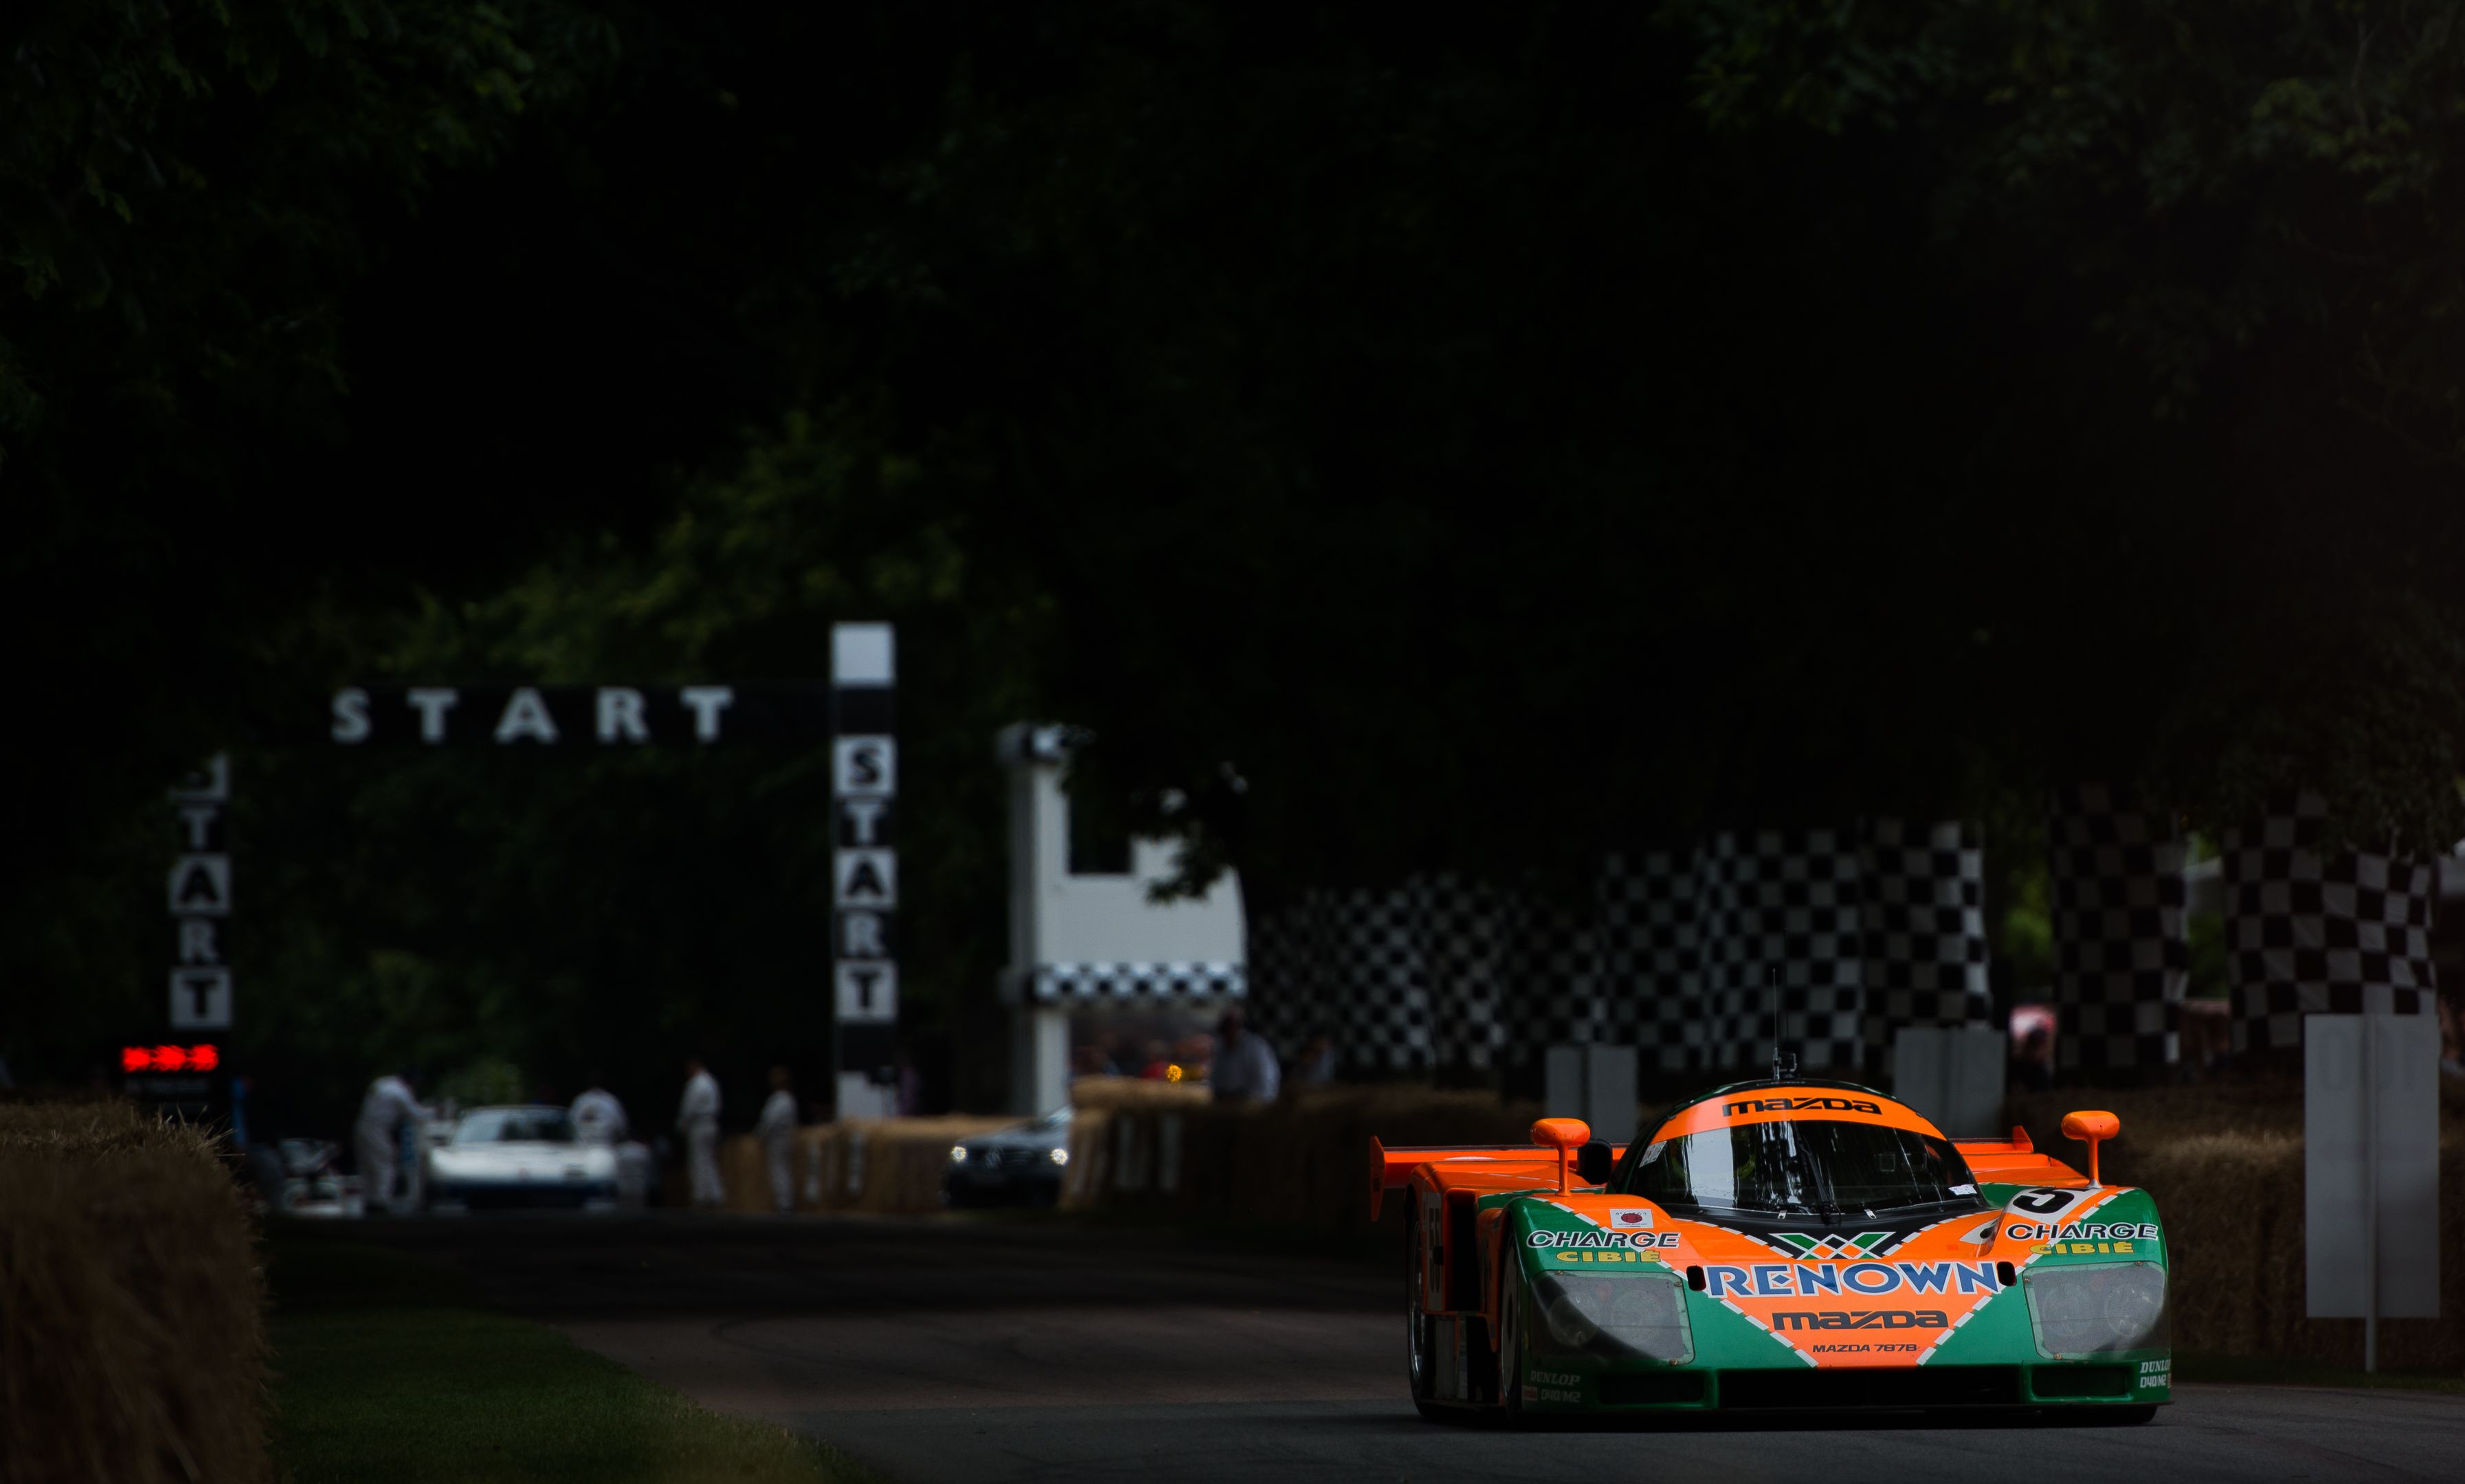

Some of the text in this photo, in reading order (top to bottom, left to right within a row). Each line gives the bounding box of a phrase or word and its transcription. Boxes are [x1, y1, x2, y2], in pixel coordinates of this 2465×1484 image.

[330, 686, 735, 746] START
[842, 746, 889, 1009] START
[1722, 1097, 1882, 1116] mazda
[1526, 1230, 1682, 1249] CHARGE
[2005, 1222, 2159, 1241] CHARGE
[2029, 1240, 2134, 1254] CIBIÉ
[1556, 1249, 1661, 1263] CIBIÉ
[1703, 1261, 2003, 1298] RENOWN
[1772, 1310, 1949, 1330] mazda
[1812, 1344, 1917, 1352] MAZDA 787B
[2139, 1358, 2171, 1373] DUNLO
[1530, 1370, 1581, 1386] DUNLOP
[2139, 1374, 2167, 1389] D40/M2
[1540, 1388, 1581, 1403] D40/M2
